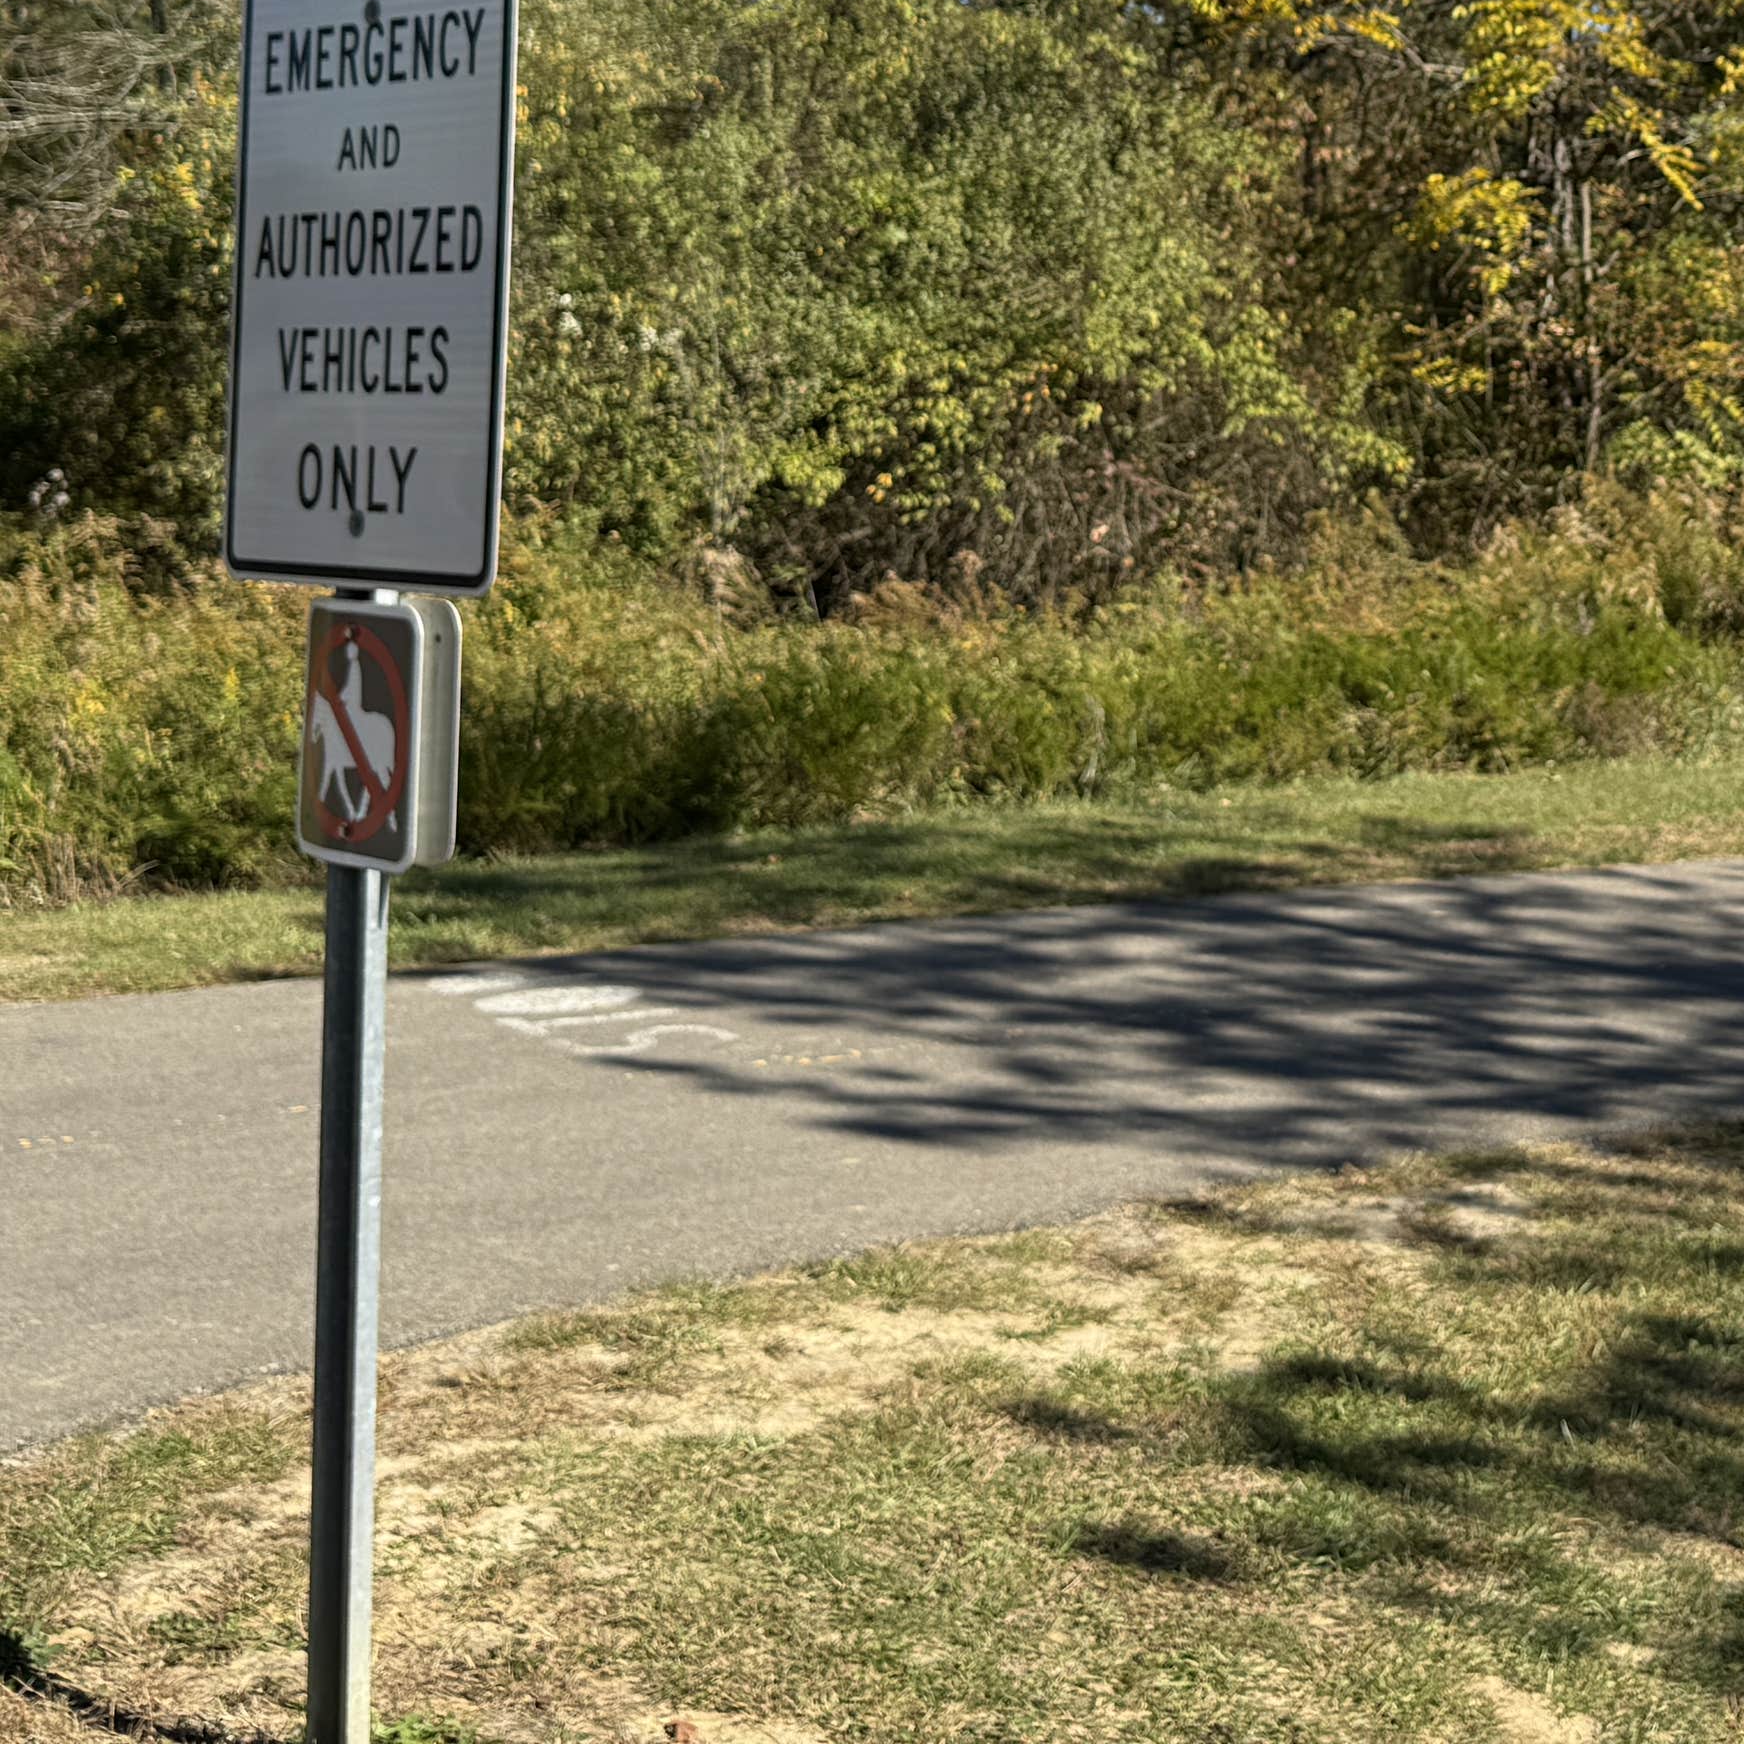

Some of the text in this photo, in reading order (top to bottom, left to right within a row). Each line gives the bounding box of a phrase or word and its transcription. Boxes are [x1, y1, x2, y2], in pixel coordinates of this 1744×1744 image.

[265, 8, 486, 94] EMERGENCY
[337, 124, 401, 171] AND
[255, 205, 484, 279] AUTHORIZED
[278, 325, 449, 394] VEHICLES
[298, 443, 418, 514] ONLY
